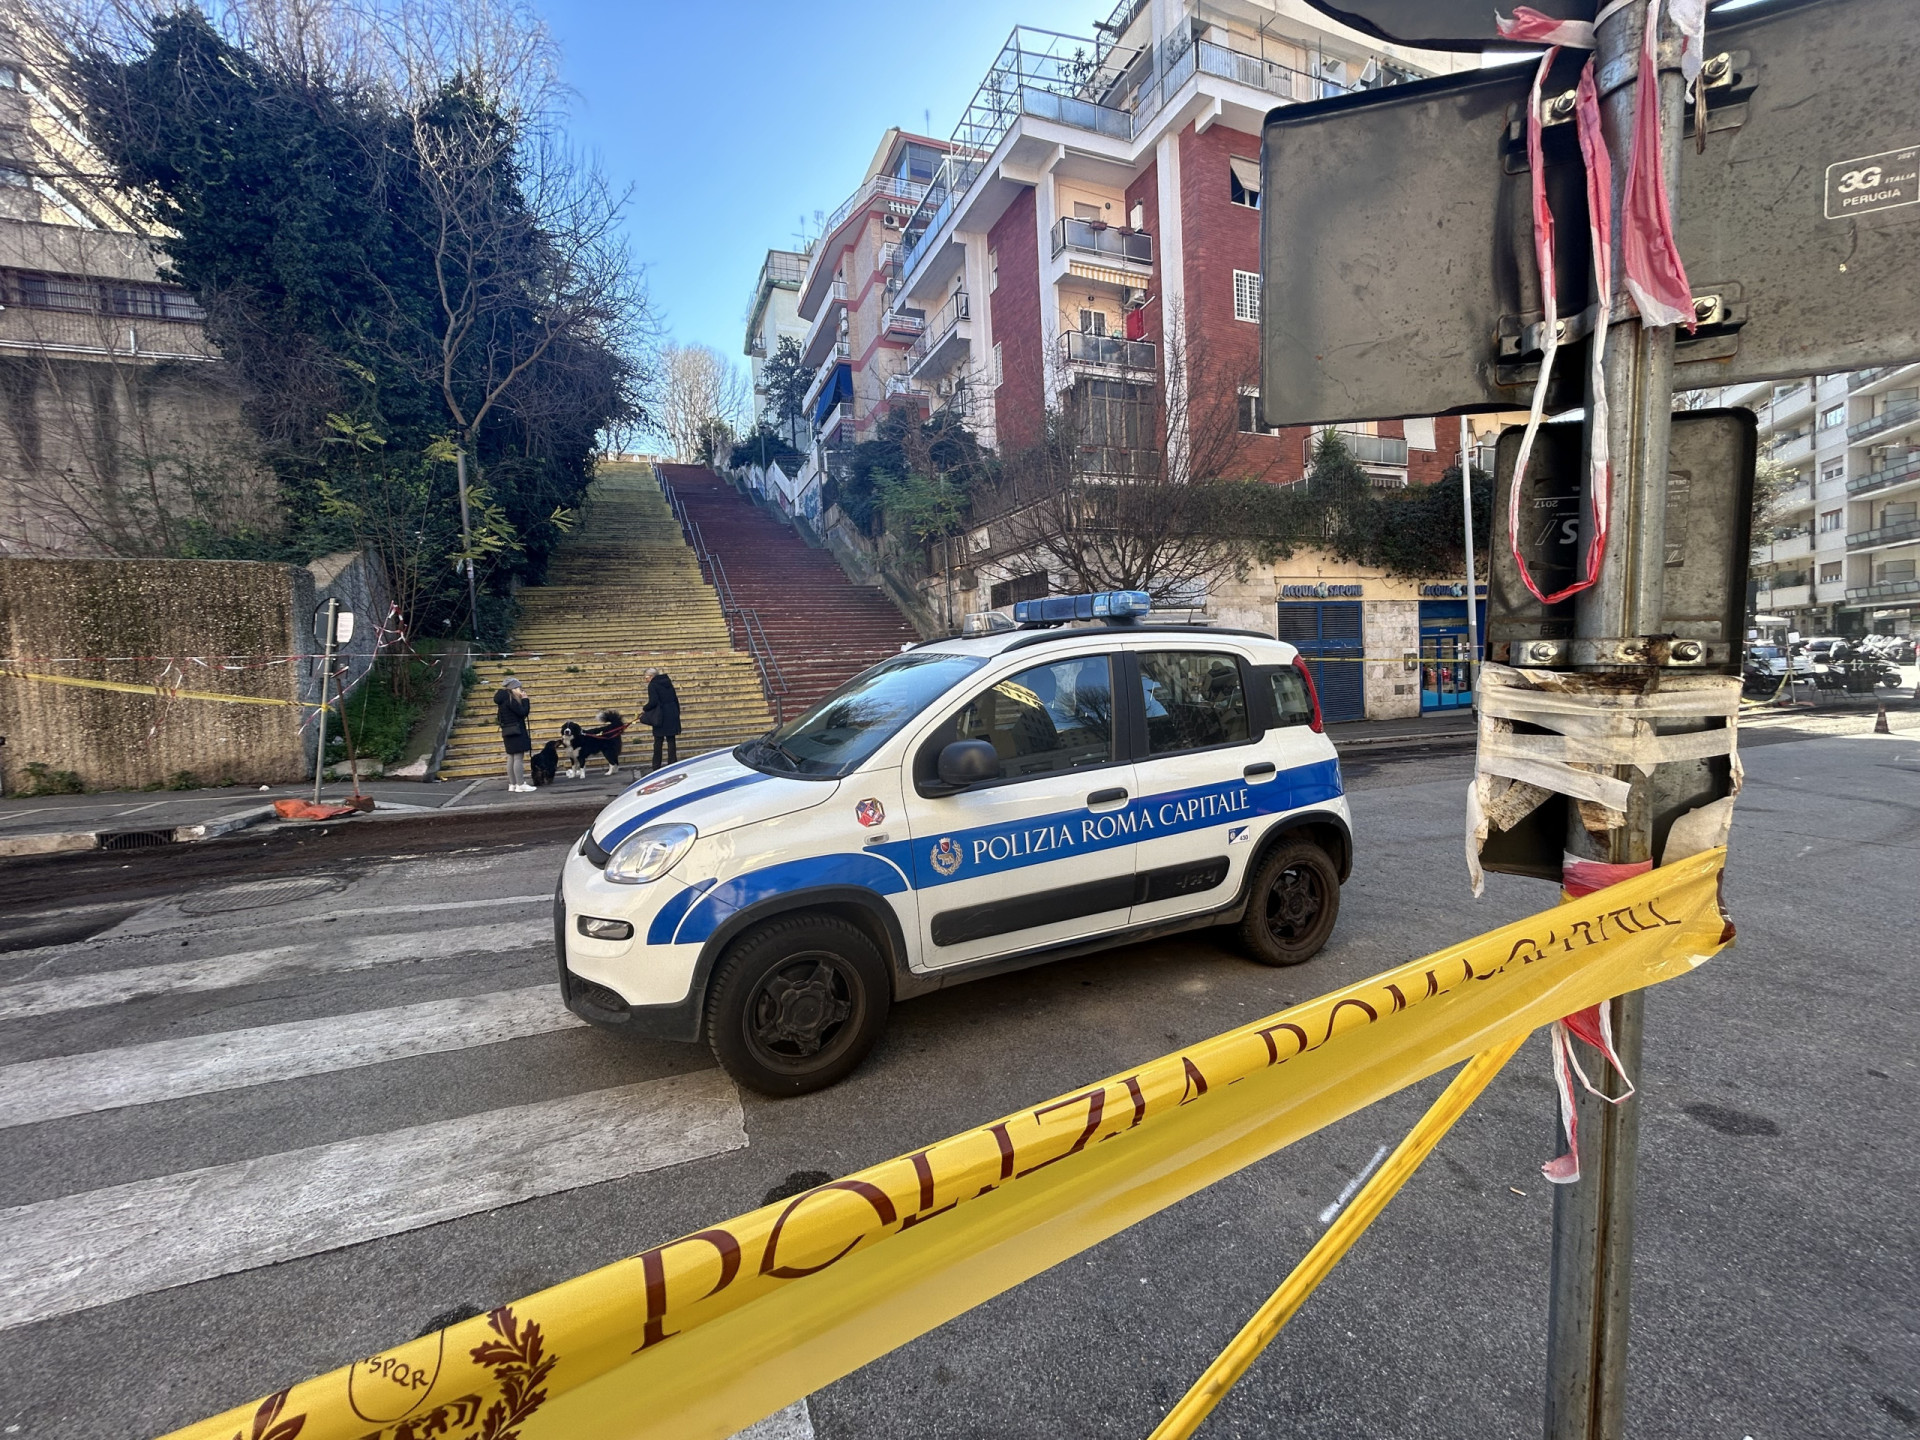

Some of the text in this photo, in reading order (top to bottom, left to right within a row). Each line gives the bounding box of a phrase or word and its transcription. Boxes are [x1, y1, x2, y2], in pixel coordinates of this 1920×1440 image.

[1838, 166, 1917, 193] 3G ITALIA
[1843, 188, 1901, 207] PERUGIA
[1533, 500, 1558, 509] 2017
[973, 788, 1250, 864] POLIZIA ROMA CAPITALE
[368, 1355, 429, 1391] SPQR
